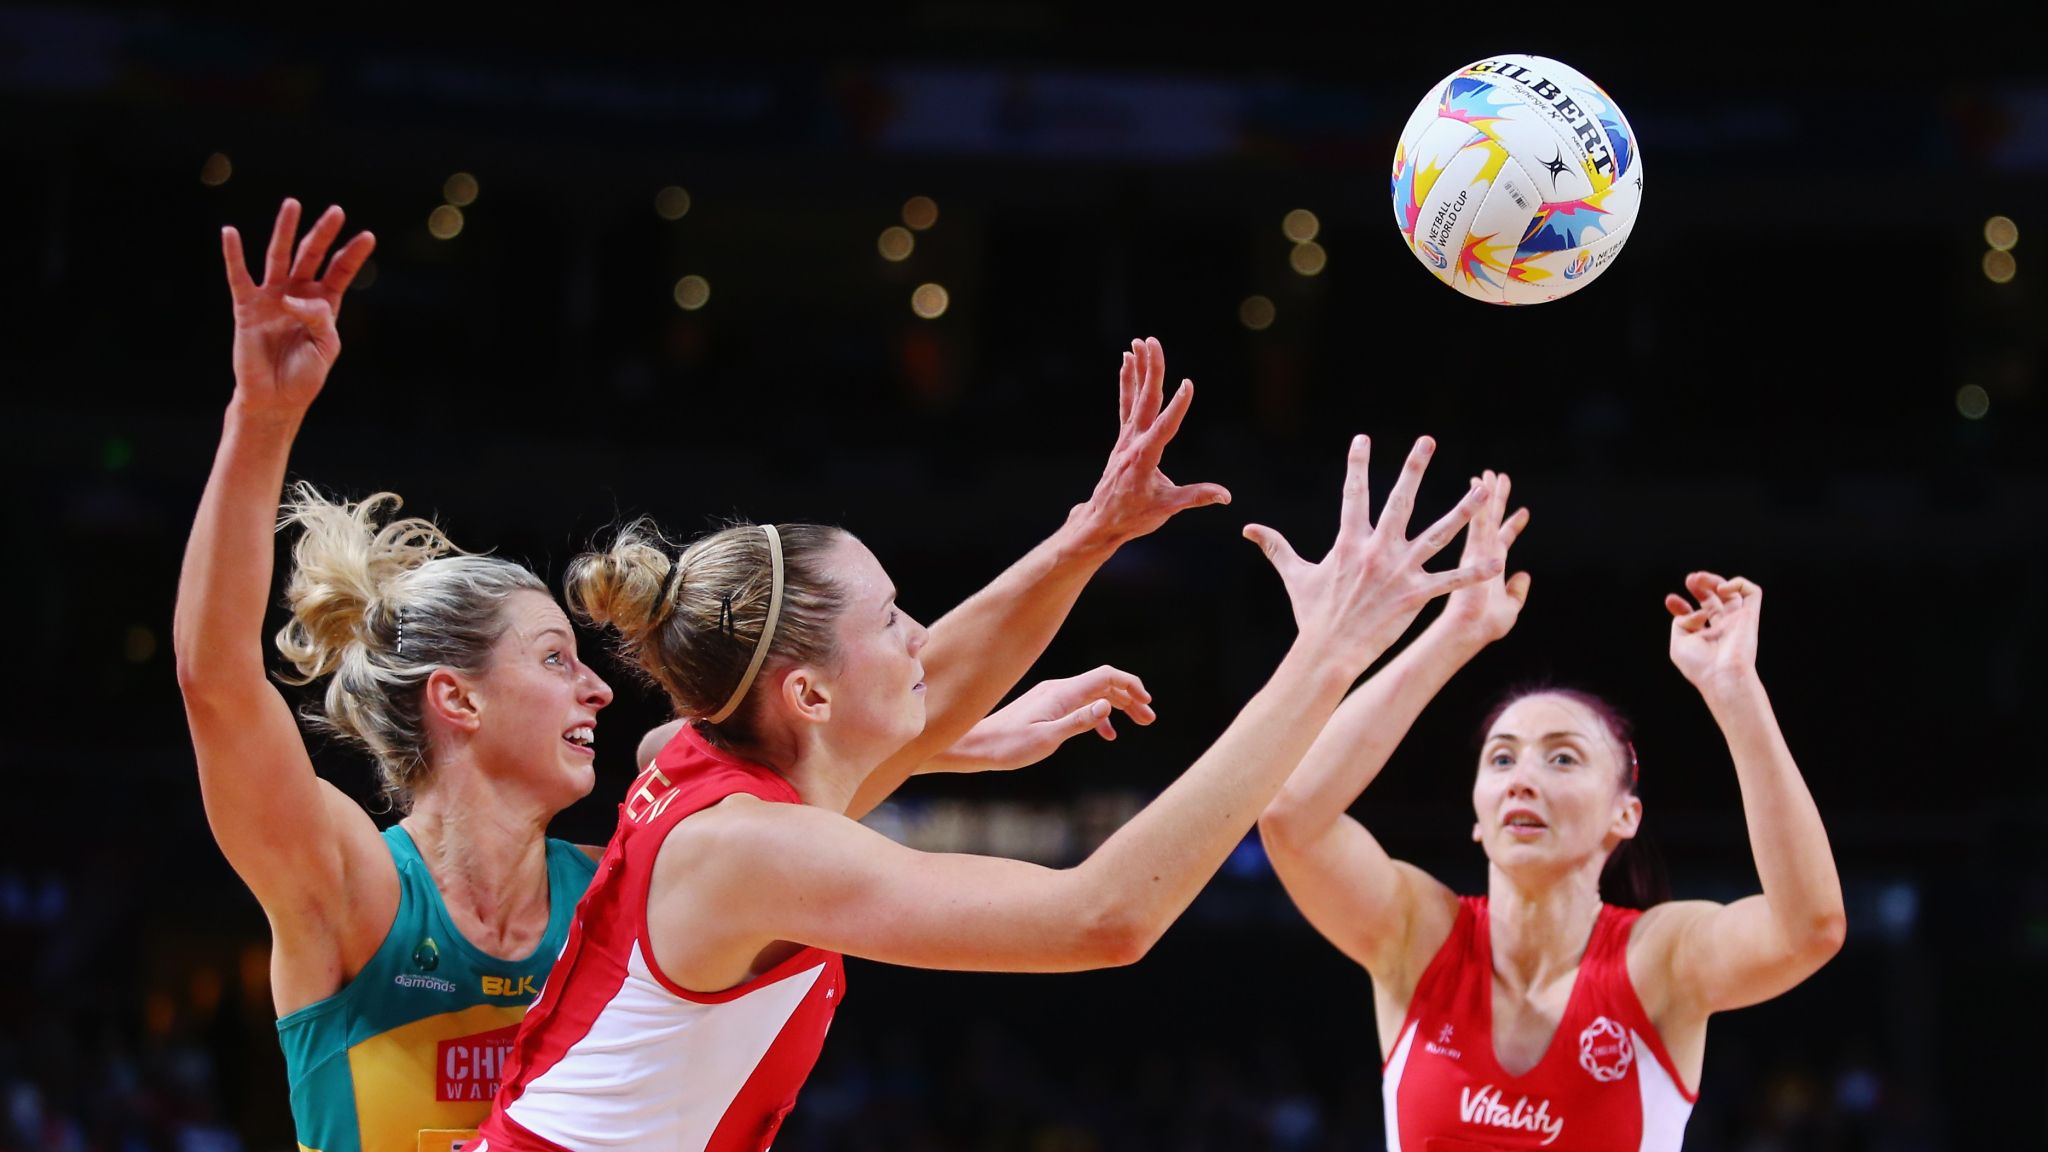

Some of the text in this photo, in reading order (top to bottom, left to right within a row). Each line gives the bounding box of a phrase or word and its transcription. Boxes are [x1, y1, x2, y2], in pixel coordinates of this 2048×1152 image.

[1470, 60, 1615, 175] GILBERT
[1429, 201, 1452, 242] NETBALL
[1437, 190, 1468, 247] WORLD CUP
[394, 974, 457, 993] diamonds
[481, 975, 538, 997] BLK
[1460, 1083, 1564, 1147] Vitality
